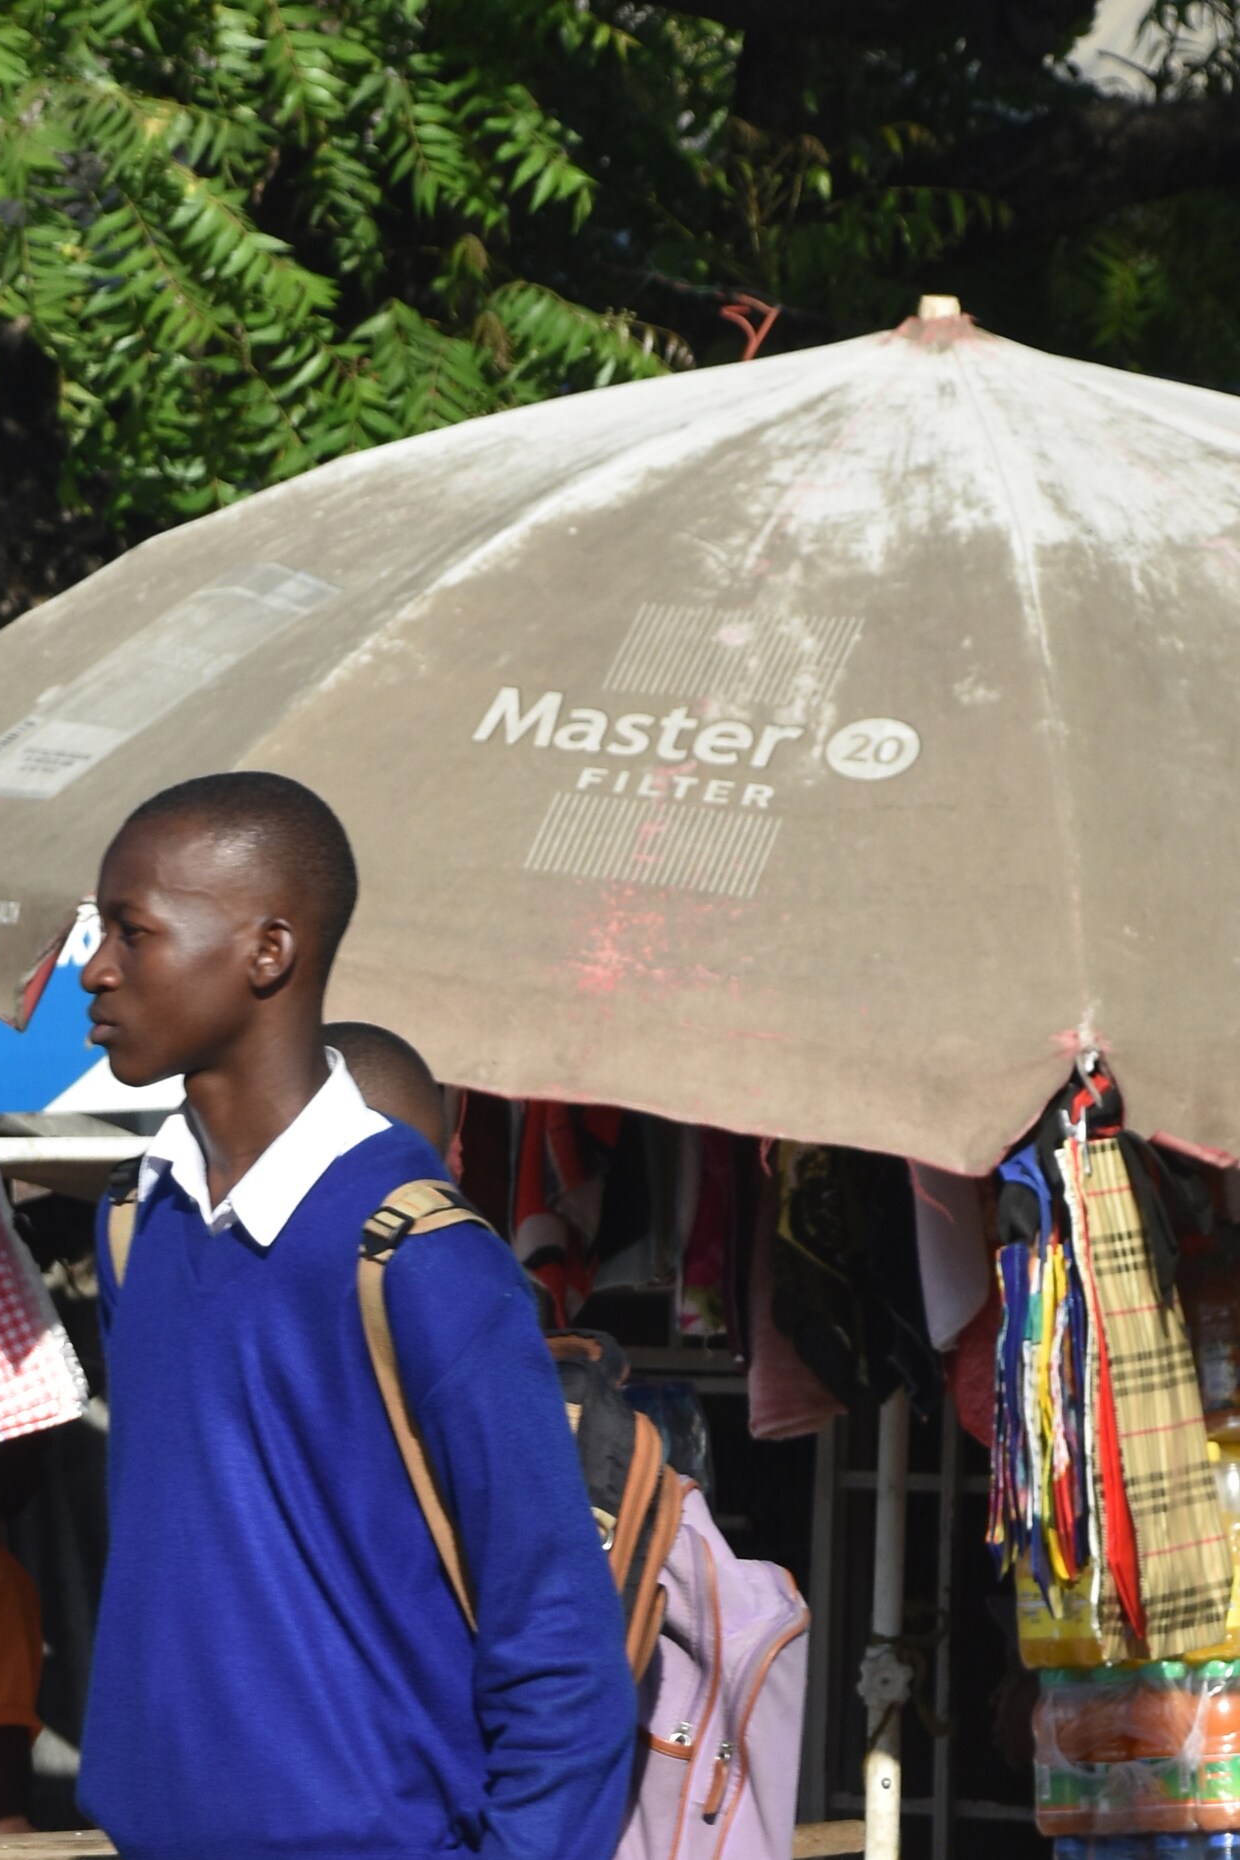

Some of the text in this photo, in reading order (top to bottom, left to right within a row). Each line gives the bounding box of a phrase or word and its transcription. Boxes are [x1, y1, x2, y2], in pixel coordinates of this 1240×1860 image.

[472, 686, 906, 768] Master 20
[576, 767, 776, 809] FILTER
